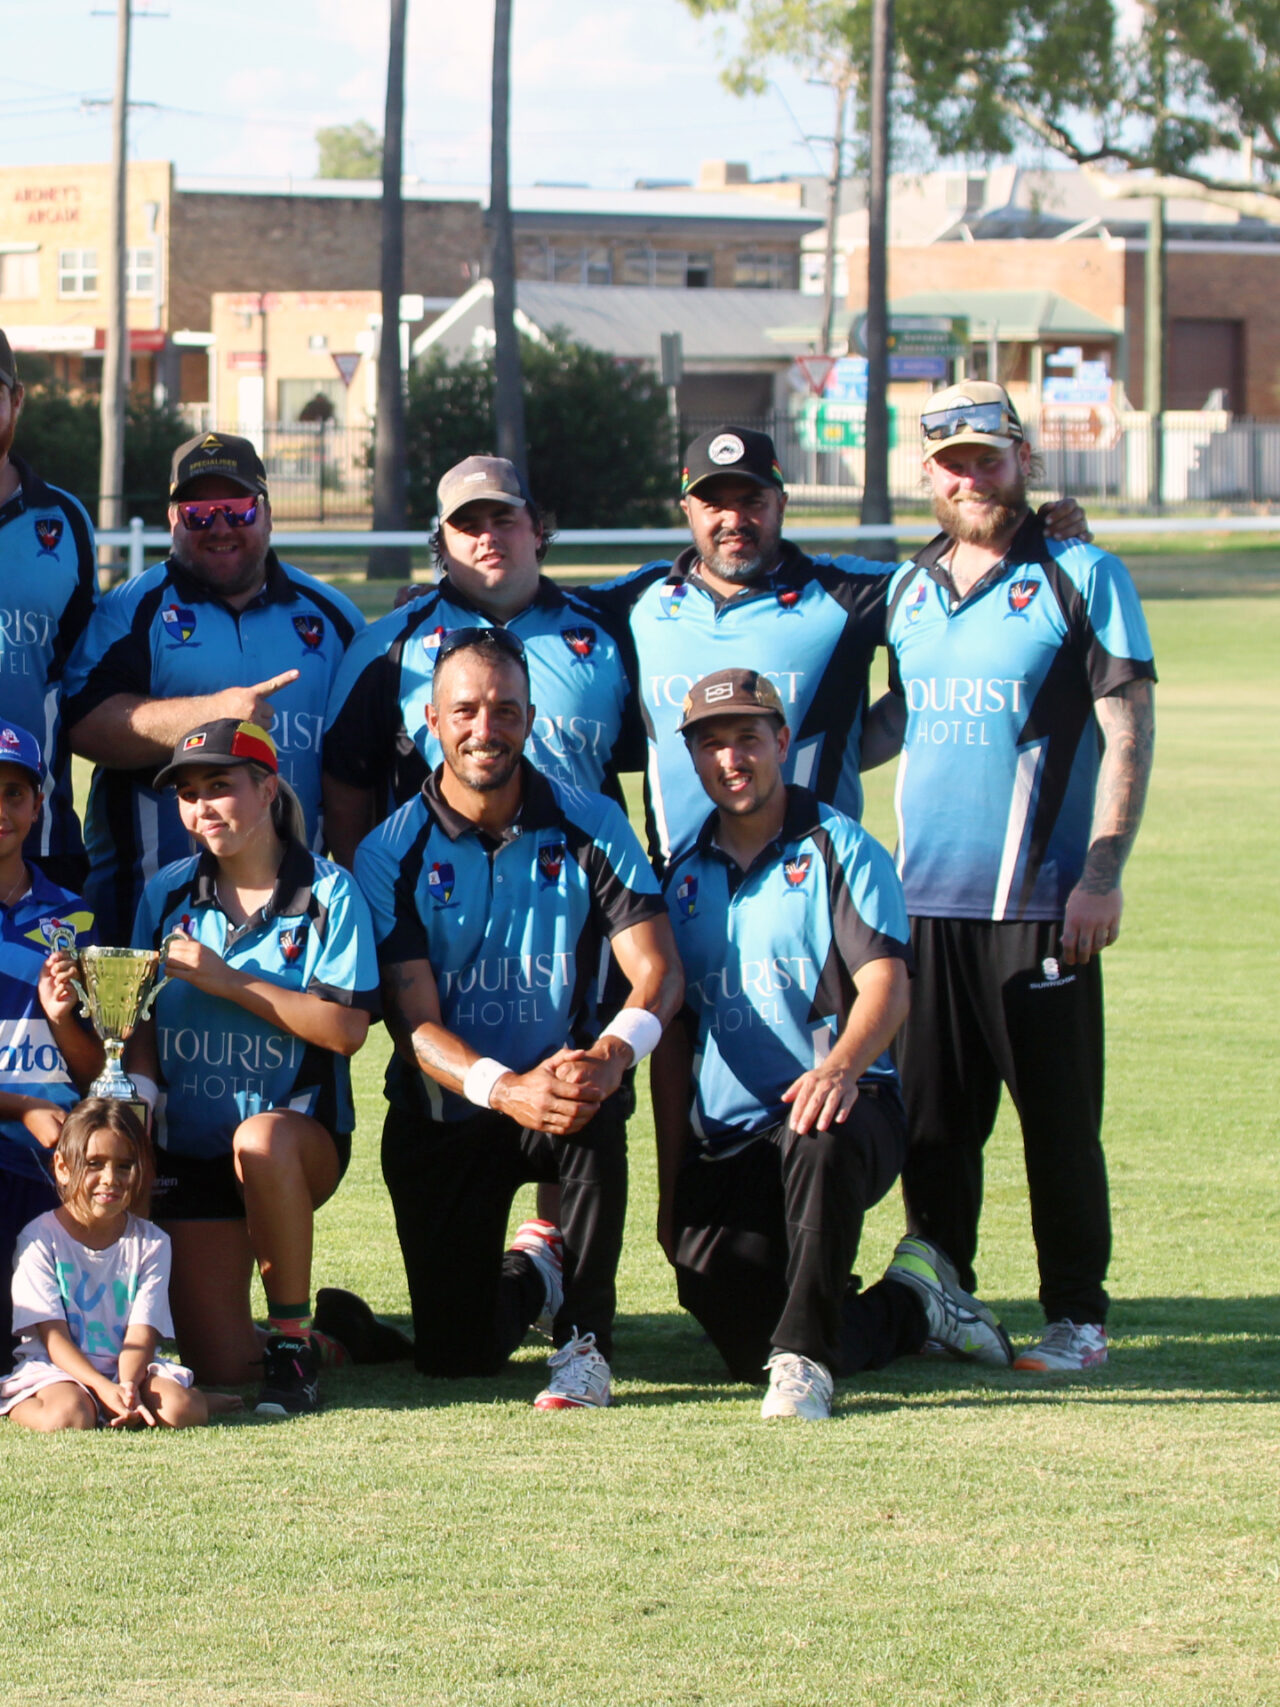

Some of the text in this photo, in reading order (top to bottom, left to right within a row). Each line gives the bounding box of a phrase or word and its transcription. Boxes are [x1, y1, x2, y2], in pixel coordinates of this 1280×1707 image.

[916, 720, 990, 745] HOTEL
[444, 952, 572, 998] TOURIST
[457, 999, 543, 1026] HOTEL
[158, 1026, 297, 1073] TOURIST
[182, 1074, 269, 1101] HOTEL
